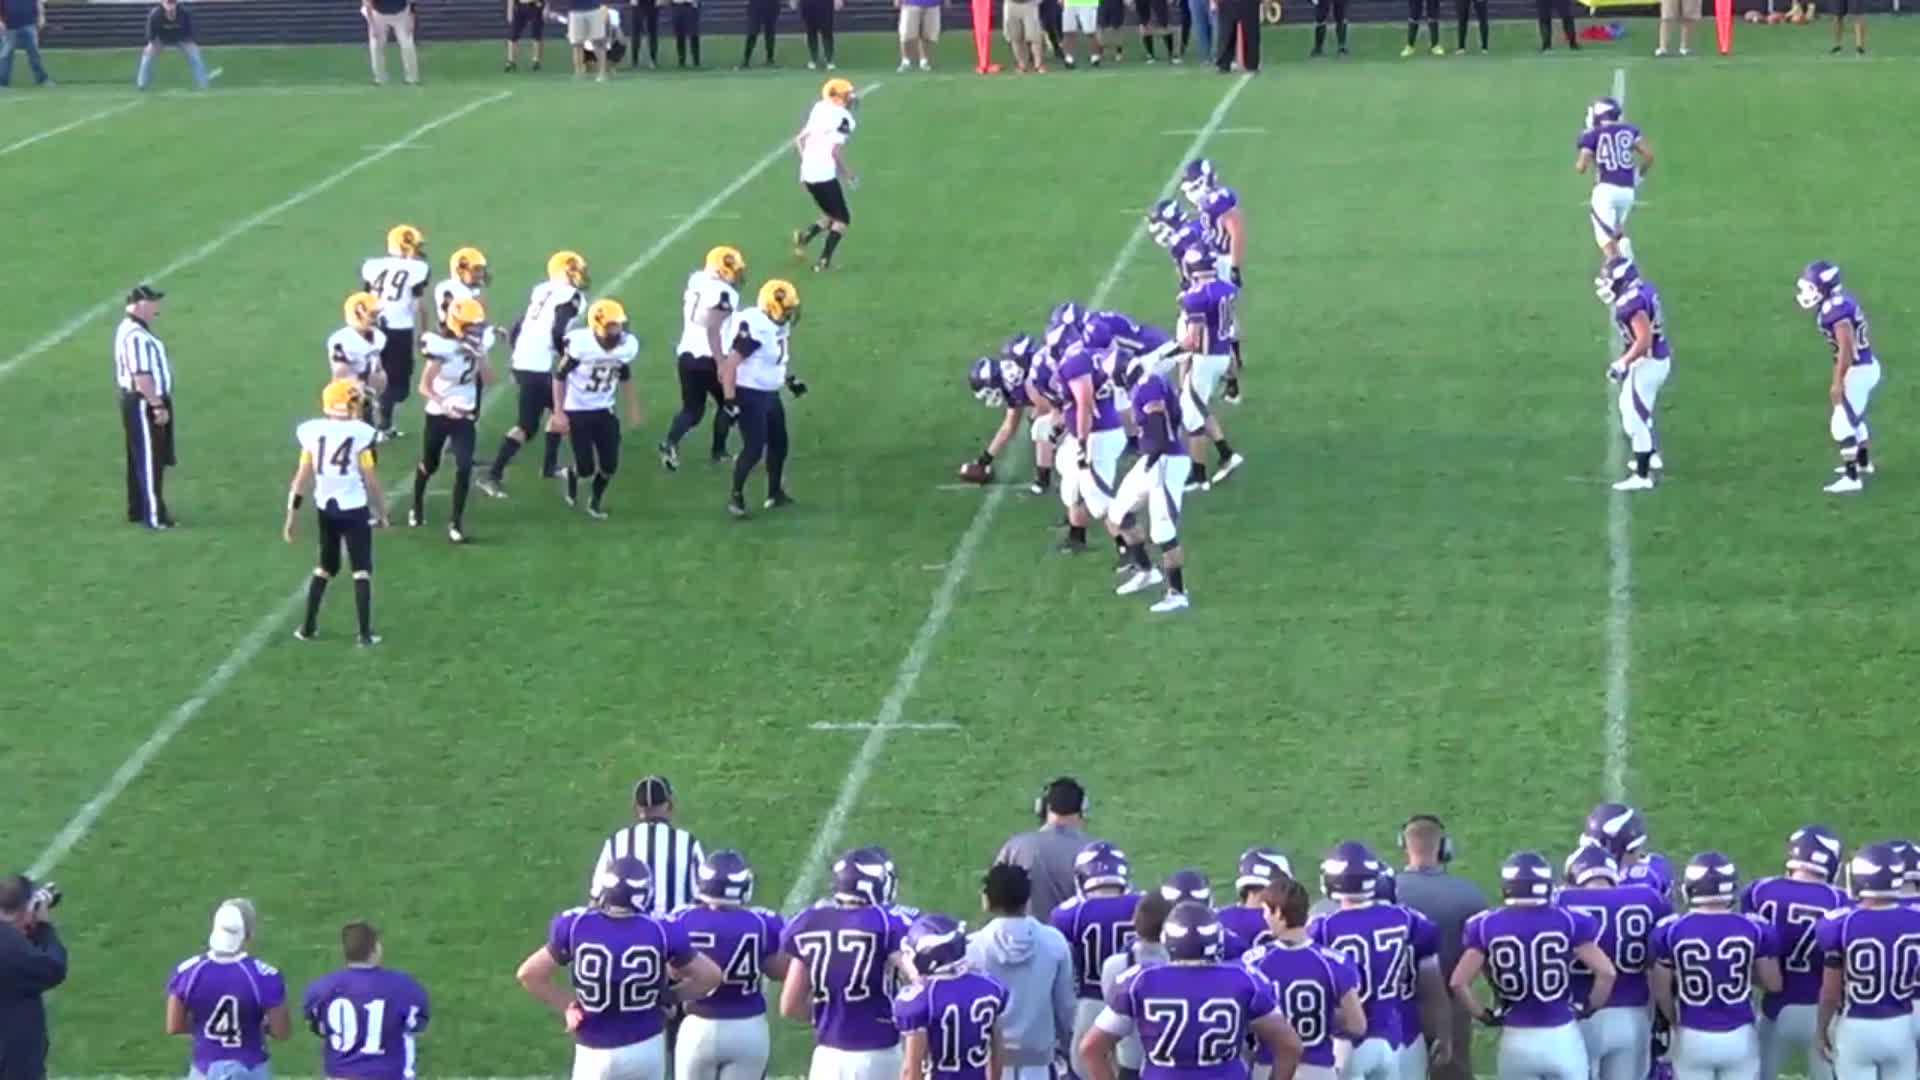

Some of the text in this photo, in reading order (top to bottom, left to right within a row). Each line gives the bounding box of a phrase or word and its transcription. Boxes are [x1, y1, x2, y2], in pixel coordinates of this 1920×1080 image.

[372, 268, 409, 302] 49
[316, 434, 356, 476] 14
[574, 942, 661, 1013] 92
[794, 929, 877, 1003] 77
[1488, 931, 1569, 1003] 86
[1674, 935, 1754, 1006] 63
[204, 994, 242, 1048] 4
[327, 997, 386, 1055] 91
[937, 996, 1002, 1072] 13
[1143, 997, 1241, 1067] 72
